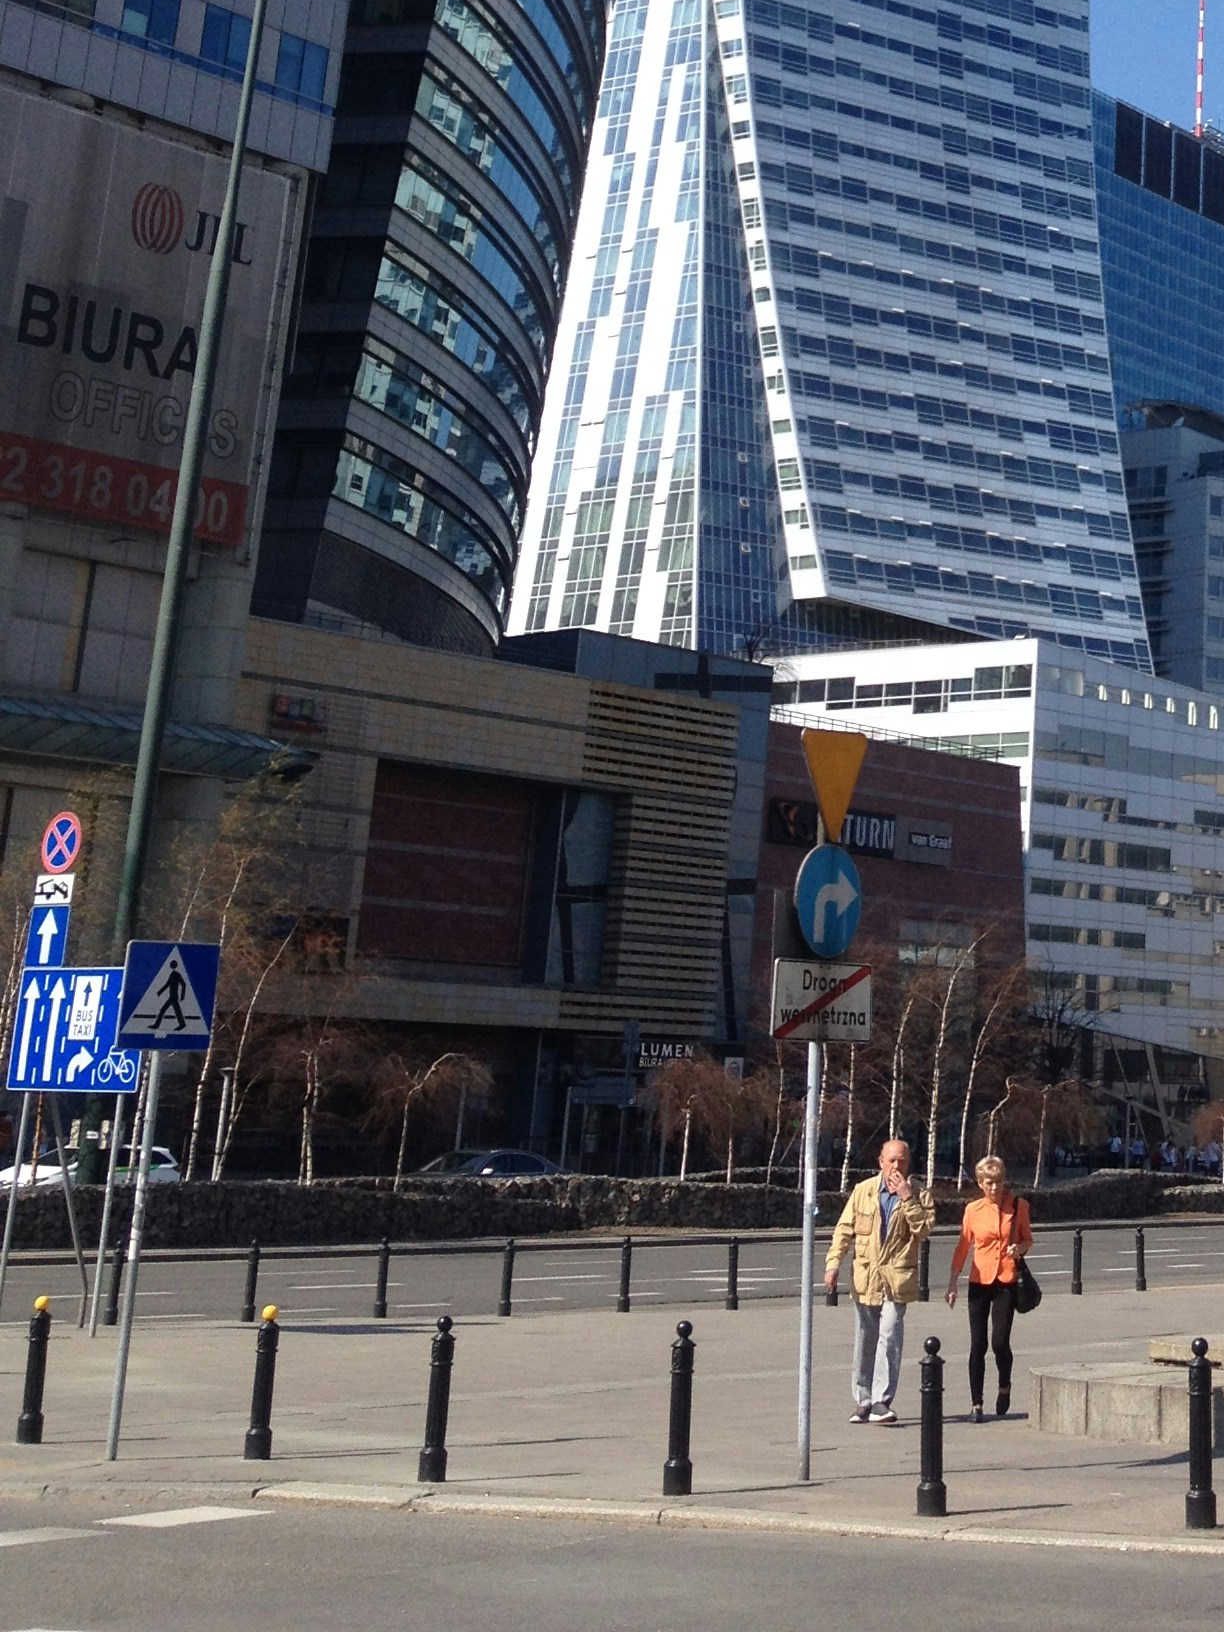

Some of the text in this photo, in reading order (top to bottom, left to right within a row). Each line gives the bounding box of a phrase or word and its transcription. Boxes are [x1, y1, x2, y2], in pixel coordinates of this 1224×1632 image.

[17, 283, 200, 380] BIURA
[49, 370, 239, 458] OFFICS
[0, 446, 27, 492] 2
[41, 455, 113, 510] 318
[127, 472, 171, 523] 04
[838, 814, 895, 849] TURN
[74, 1024, 92, 1036] TAXI
[76, 1010, 93, 1022] BUS
[641, 1042, 694, 1058] LUMEN
